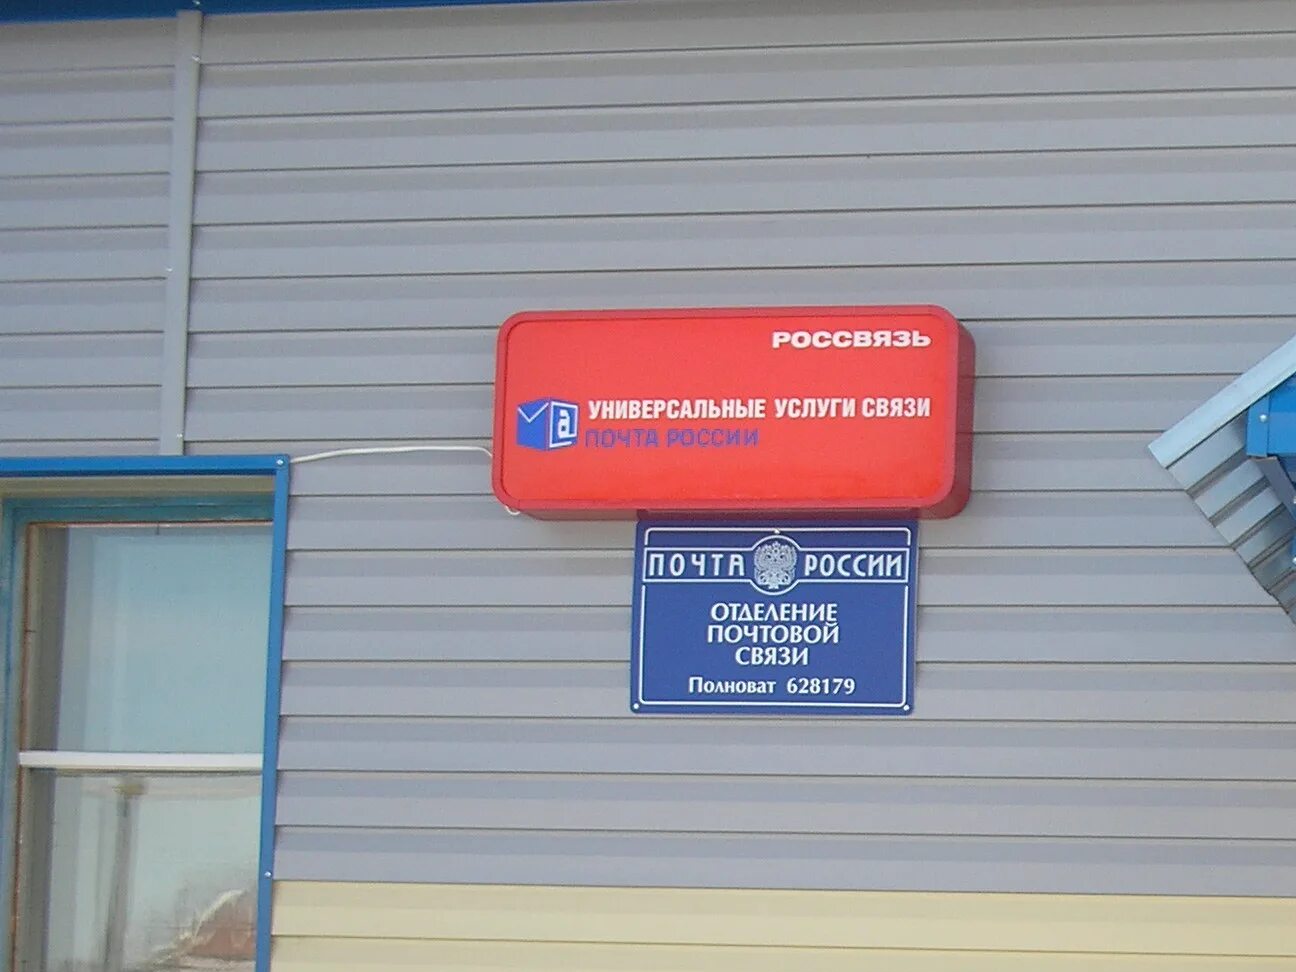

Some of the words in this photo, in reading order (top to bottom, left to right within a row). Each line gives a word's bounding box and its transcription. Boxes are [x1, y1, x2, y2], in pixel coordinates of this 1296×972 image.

[772, 330, 932, 349] РОССВЯЗЬ
[587, 397, 766, 421] УНИВЕРСАЛЬНЫЕ
[774, 397, 855, 419] УСЛУГИ
[861, 396, 931, 418] СВЯЗИ
[585, 429, 659, 448] ПОЧТА
[666, 428, 760, 448] РОССИИ
[649, 553, 745, 577] ПОЧТА
[804, 553, 903, 577] РОССИИ
[710, 603, 838, 622] ОТДЕЛЕНИЕ
[707, 622, 840, 644] ПОЧТОВОЙ
[735, 646, 809, 666] СВЯЗИ
[688, 676, 776, 694] Полноват
[786, 677, 856, 695] 628179
